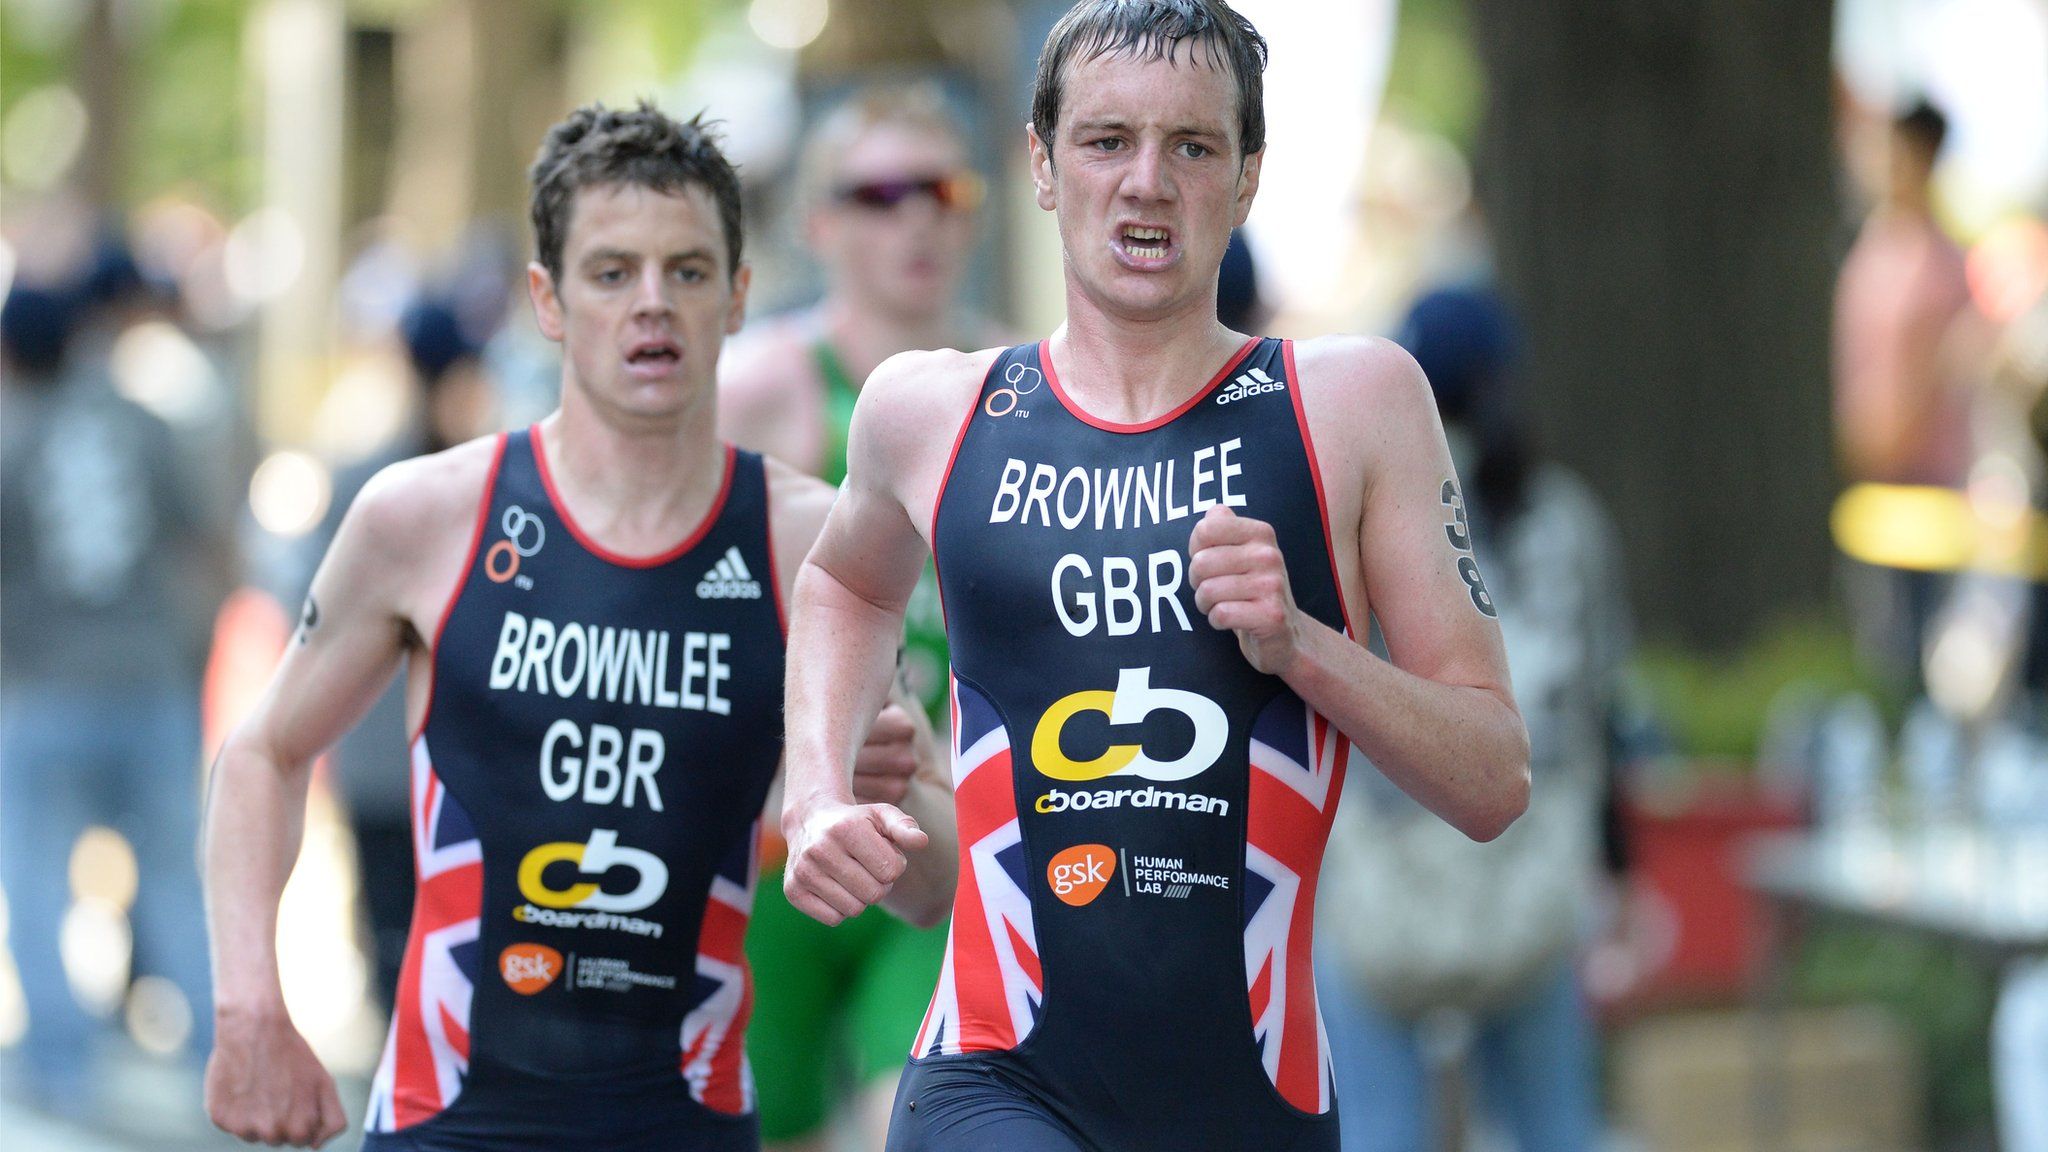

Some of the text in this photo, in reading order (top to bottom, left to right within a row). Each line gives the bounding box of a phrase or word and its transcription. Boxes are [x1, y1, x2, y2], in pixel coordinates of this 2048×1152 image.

[1216, 380, 1285, 405] adidas
[1015, 410, 1030, 418] ITU
[989, 437, 1247, 530] BROWNLEE
[696, 580, 762, 599] adidas
[1051, 549, 1193, 637] GBR
[489, 610, 731, 716] BROWNLEE
[540, 718, 665, 812] GBR
[1053, 853, 1107, 894] gsk
[1134, 856, 1183, 870] HUMAN
[1135, 869, 1229, 889] PERFORMANCE
[1136, 881, 1162, 894] LAB
[503, 953, 553, 983] gsk
